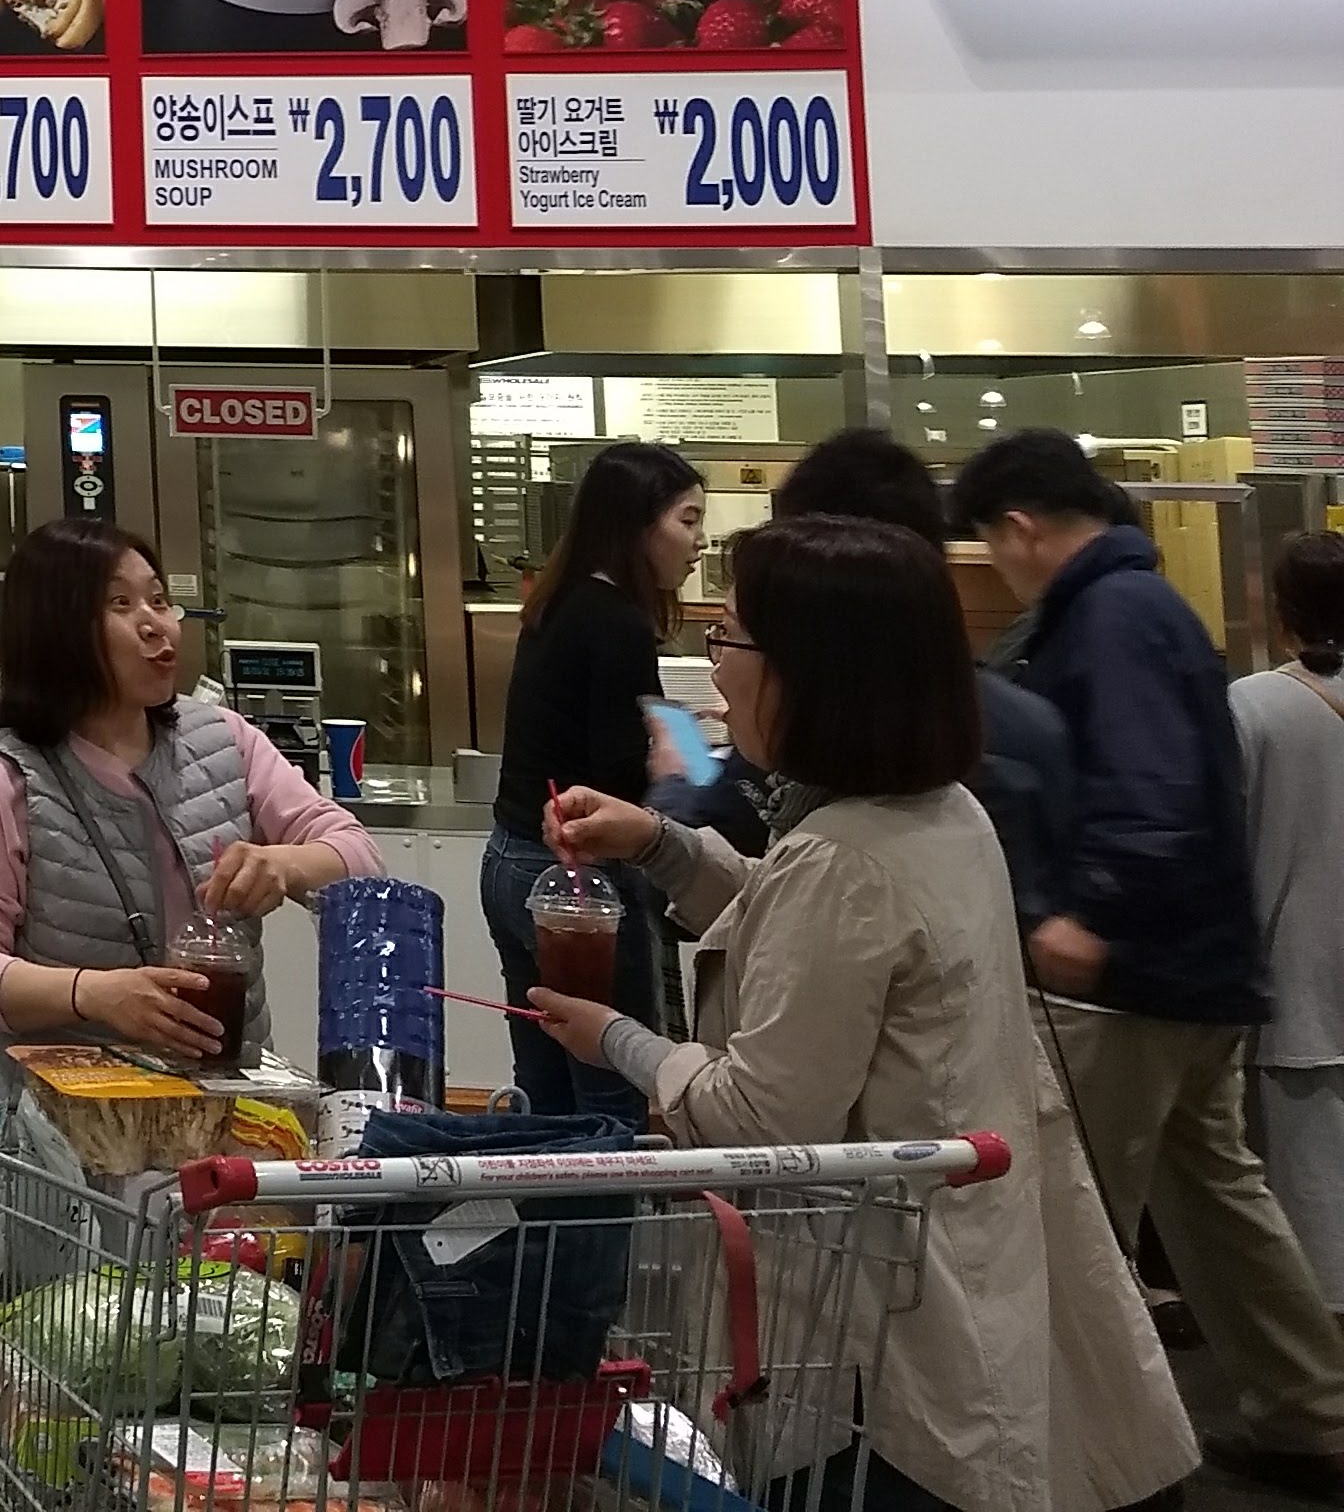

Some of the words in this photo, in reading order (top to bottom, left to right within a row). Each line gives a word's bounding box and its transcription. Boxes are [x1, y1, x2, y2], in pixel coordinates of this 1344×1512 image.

[152, 94, 277, 142] 양송이스프
[517, 97, 556, 125] 딸기
[564, 96, 625, 124] 요거트
[518, 129, 617, 157] 아이스크림
[154, 159, 278, 180] MUSHROOM
[519, 165, 600, 188] Strawberry
[155, 186, 212, 207] SOUP
[520, 190, 569, 212] Yogurt
[573, 190, 594, 208] Ice
[598, 189, 647, 208] Cream
[180, 398, 307, 428] CLOSED
